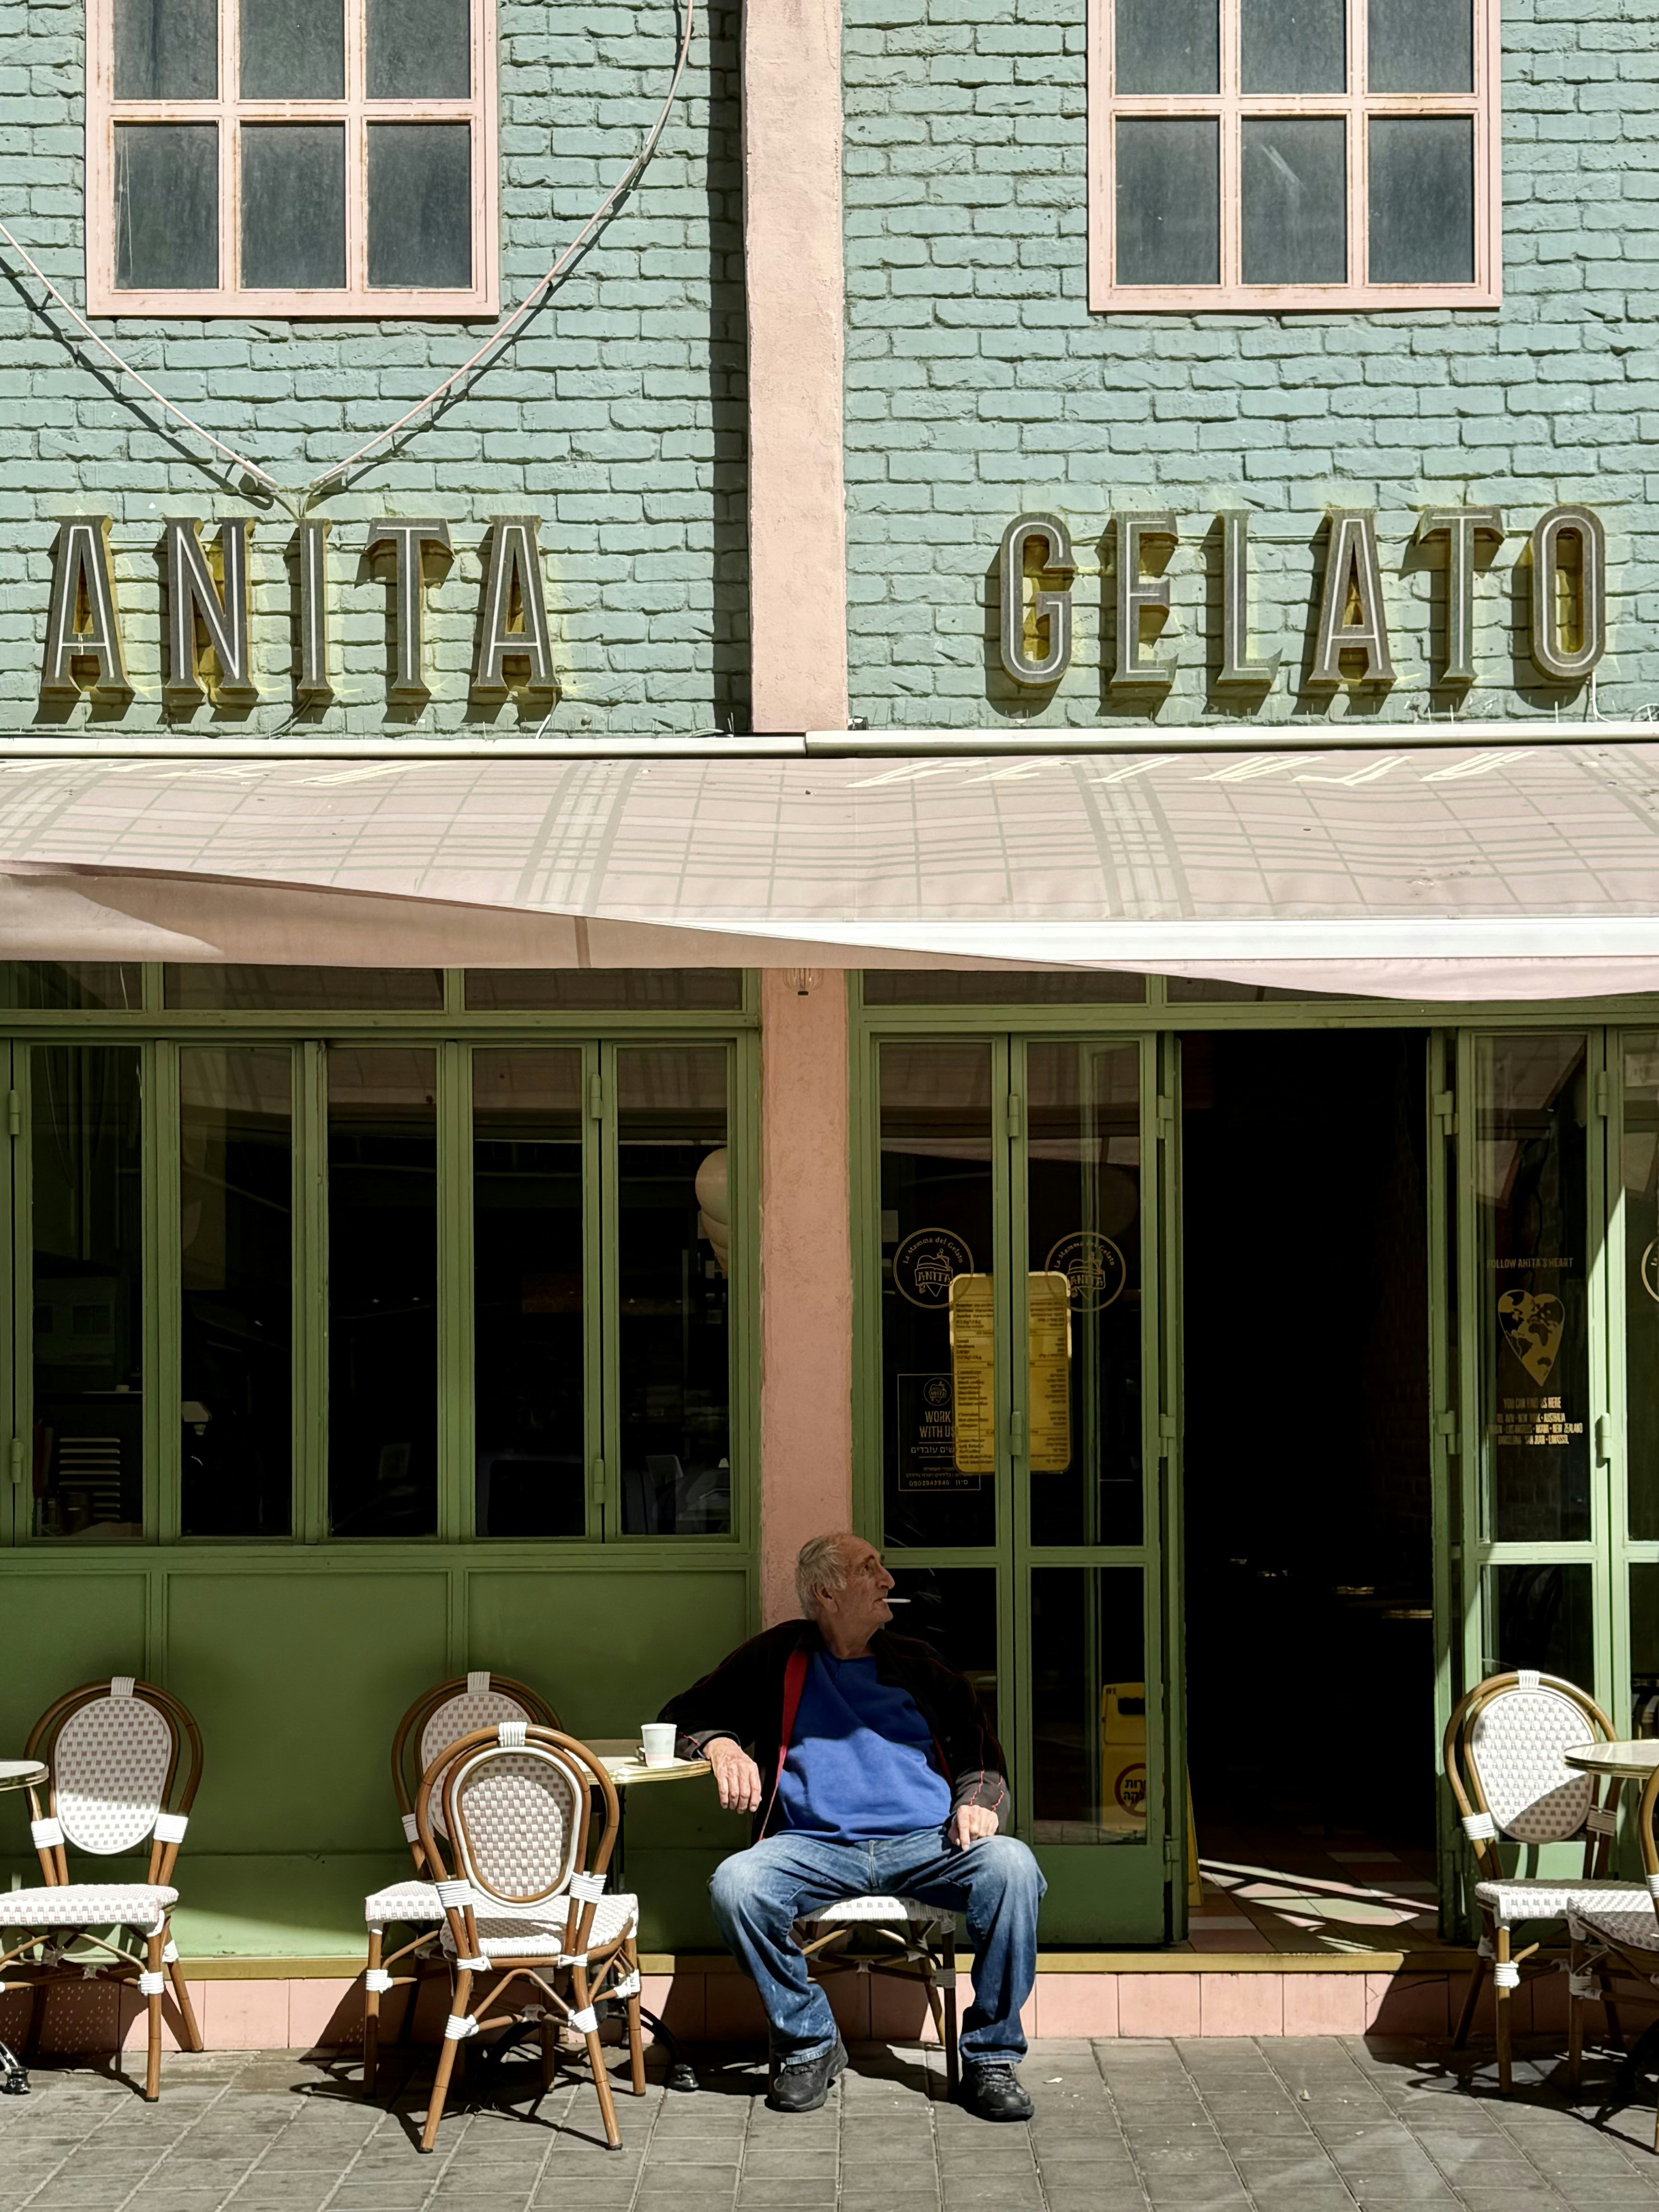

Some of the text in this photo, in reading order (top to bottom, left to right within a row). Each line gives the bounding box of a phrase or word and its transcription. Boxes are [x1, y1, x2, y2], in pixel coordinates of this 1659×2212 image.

[1000, 504, 1607, 689] GELATO
[41, 515, 559, 693] ANITA
[903, 1236, 963, 1264] La Mamma del Gelato
[1486, 1258, 1516, 1269] FOLLOW
[1549, 1257, 1575, 1268] HEART
[918, 1271, 951, 1283] ANITA
[924, 1410, 952, 1423] WORK
[919, 1426, 943, 1438] WITH
